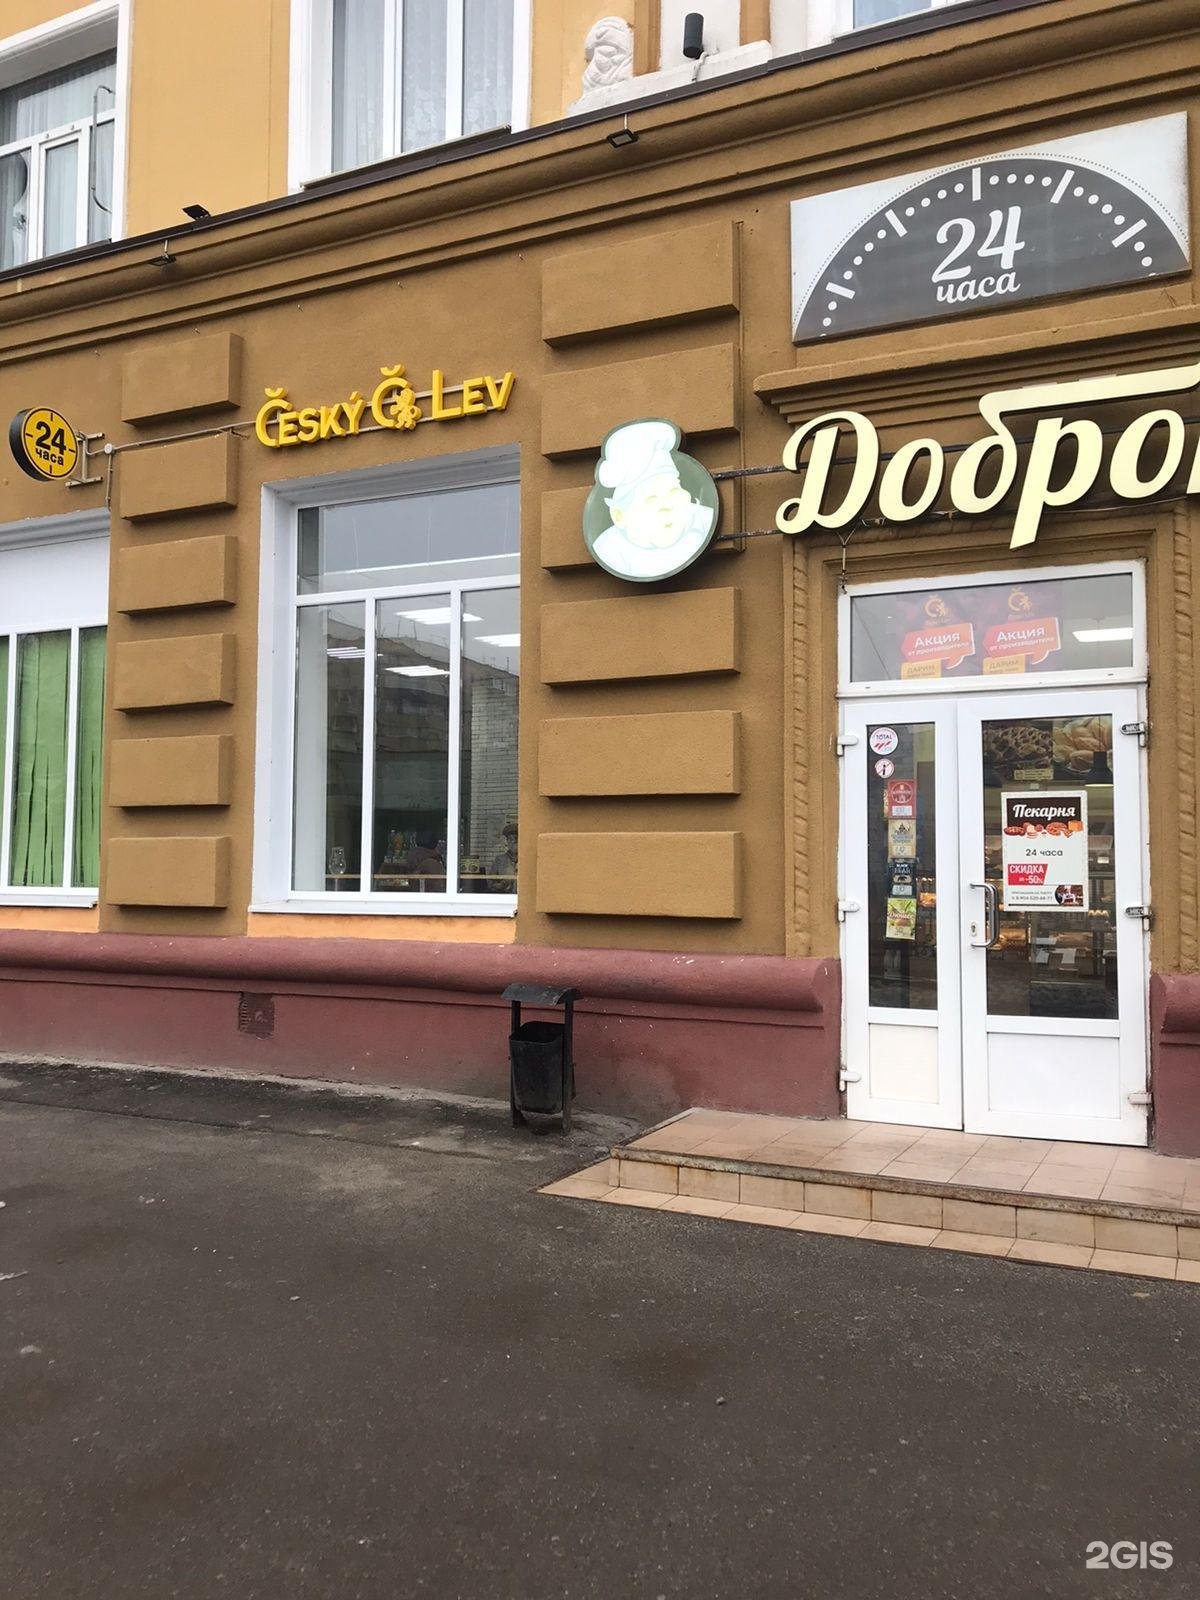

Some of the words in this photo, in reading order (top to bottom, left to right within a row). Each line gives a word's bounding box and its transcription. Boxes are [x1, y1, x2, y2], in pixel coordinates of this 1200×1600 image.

[932, 206, 1025, 283] 24
[937, 271, 1020, 303] часа
[255, 387, 366, 447] ČESKÝ
[432, 369, 514, 421] LEV
[35, 421, 67, 456] 24
[35, 447, 64, 466] часа
[914, 632, 961, 649] Акция
[996, 627, 1045, 643] Акция
[1012, 803, 1076, 821] Пекарня
[1025, 848, 1037, 857] 24
[1040, 849, 1063, 857] часа
[1009, 864, 1045, 875] СКИДКА
